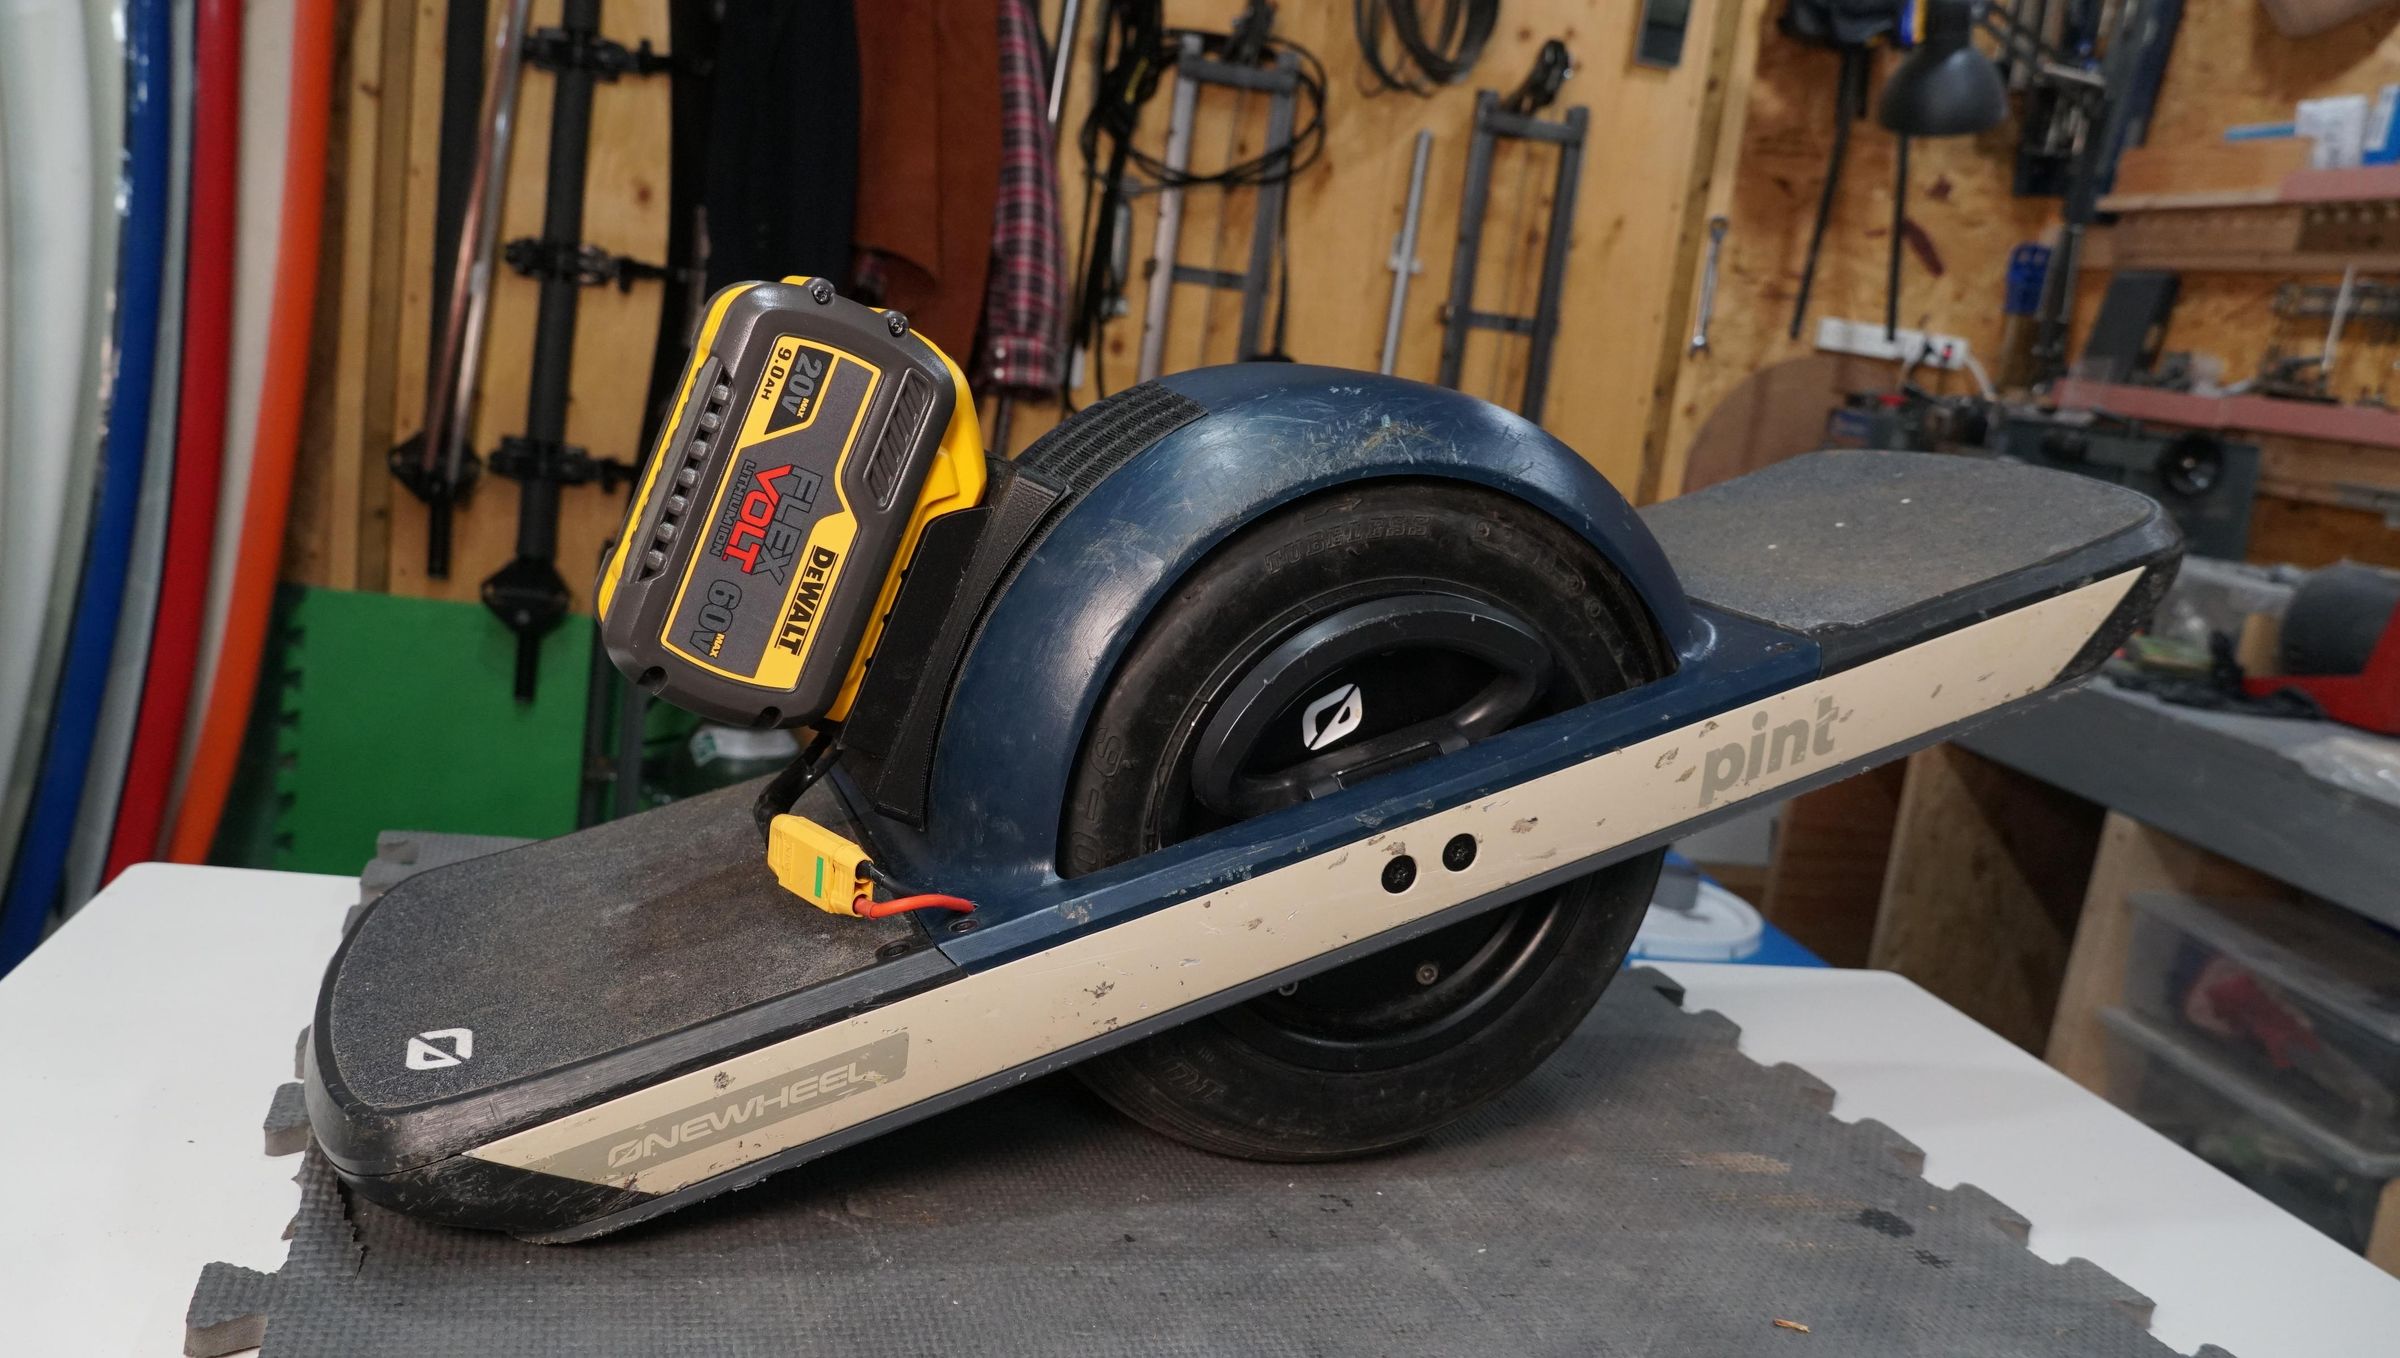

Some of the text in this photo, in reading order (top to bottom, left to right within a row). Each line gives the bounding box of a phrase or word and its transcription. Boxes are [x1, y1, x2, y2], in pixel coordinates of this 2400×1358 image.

[782, 353, 823, 418] 20V MAX
[709, 459, 757, 557] LITHIUM ION
[723, 464, 794, 575] VOLT
[751, 464, 823, 586] FLEX
[1264, 515, 1432, 575] TUBELESS
[690, 579, 742, 659] 60V MAX
[1700, 695, 1840, 808] pint
